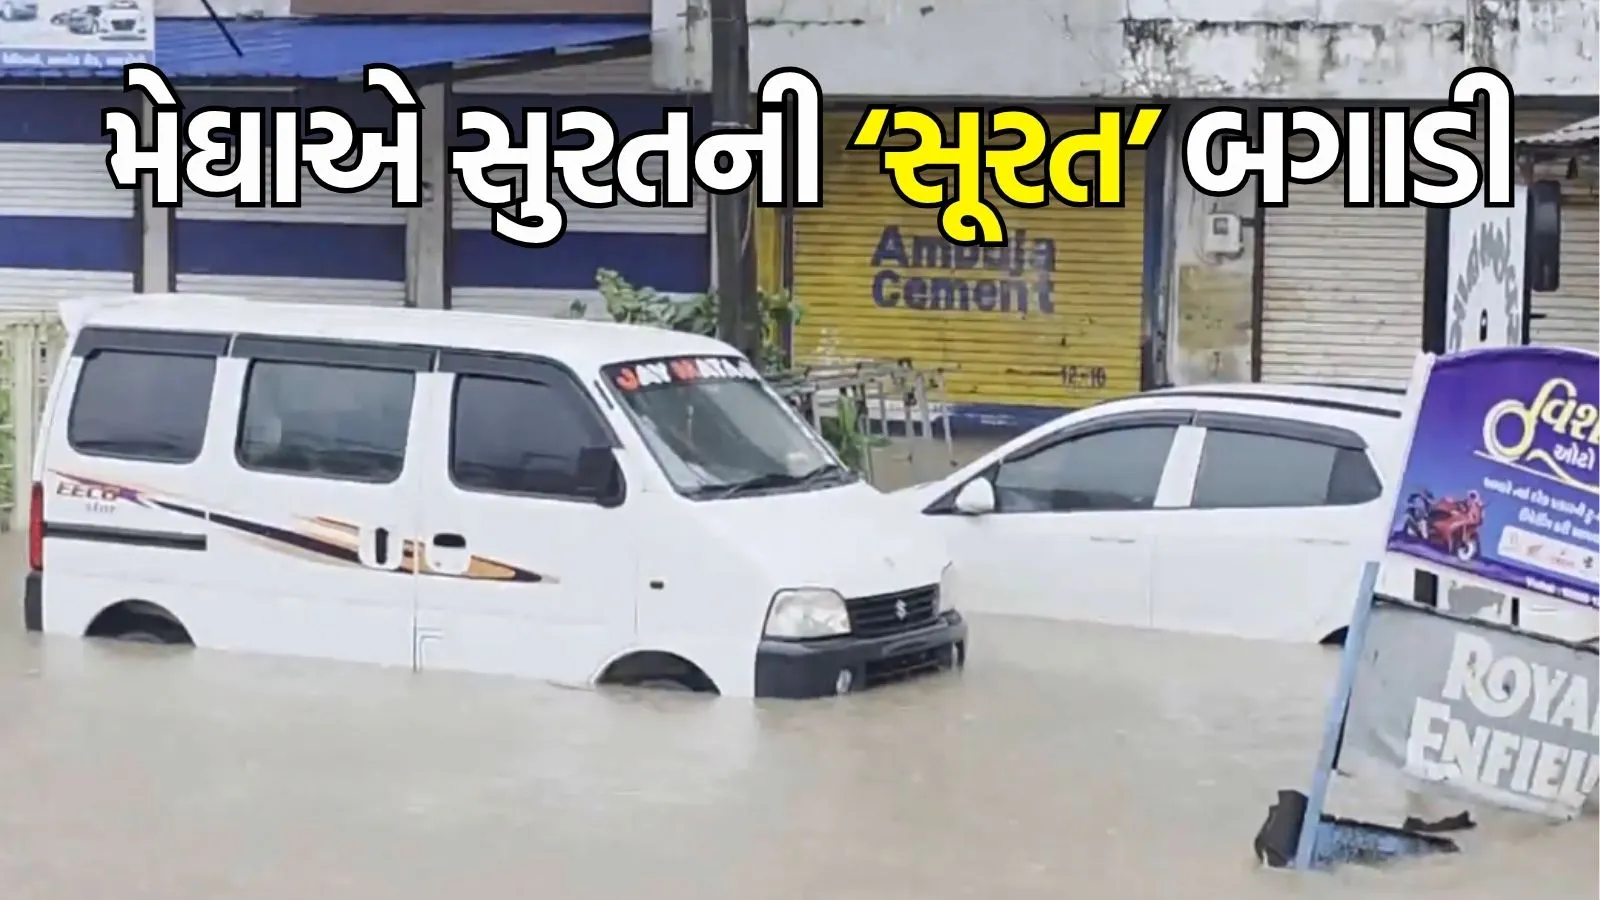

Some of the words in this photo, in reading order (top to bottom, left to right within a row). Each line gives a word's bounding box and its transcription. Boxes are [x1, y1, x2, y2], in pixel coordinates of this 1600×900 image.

[872, 270, 1055, 314] Cement
[616, 362, 671, 391] JAY
[57, 480, 117, 500] EECO
[1441, 632, 1599, 736] ROYA
